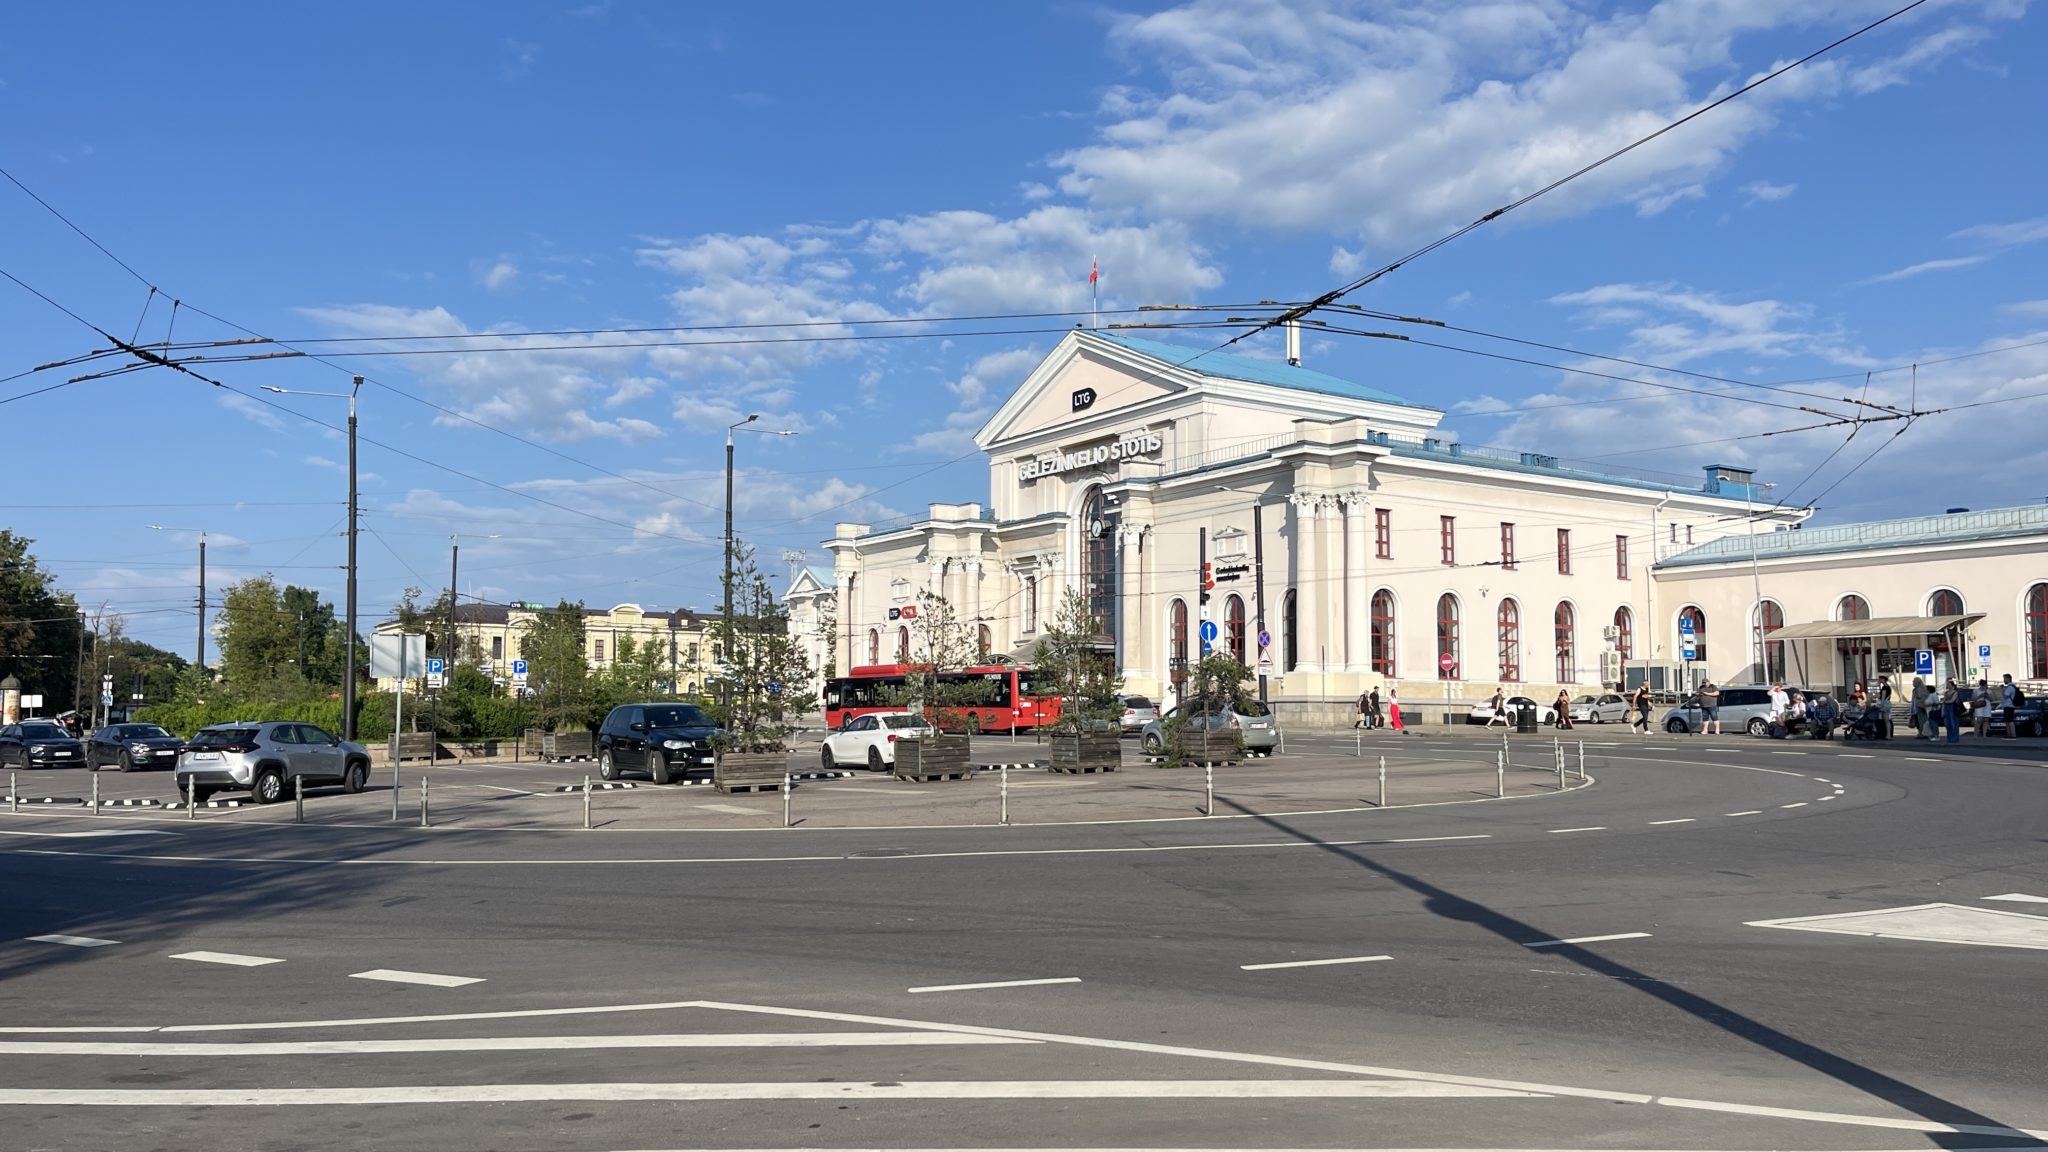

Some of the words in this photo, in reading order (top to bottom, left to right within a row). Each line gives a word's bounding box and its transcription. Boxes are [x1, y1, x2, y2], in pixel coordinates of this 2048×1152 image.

[1074, 392, 1090, 406] LTG
[1110, 431, 1162, 460] STOTIS
[1981, 646, 1989, 655] P
[1919, 652, 1929, 664] P
[431, 661, 440, 672] P
[516, 661, 525, 672] P
